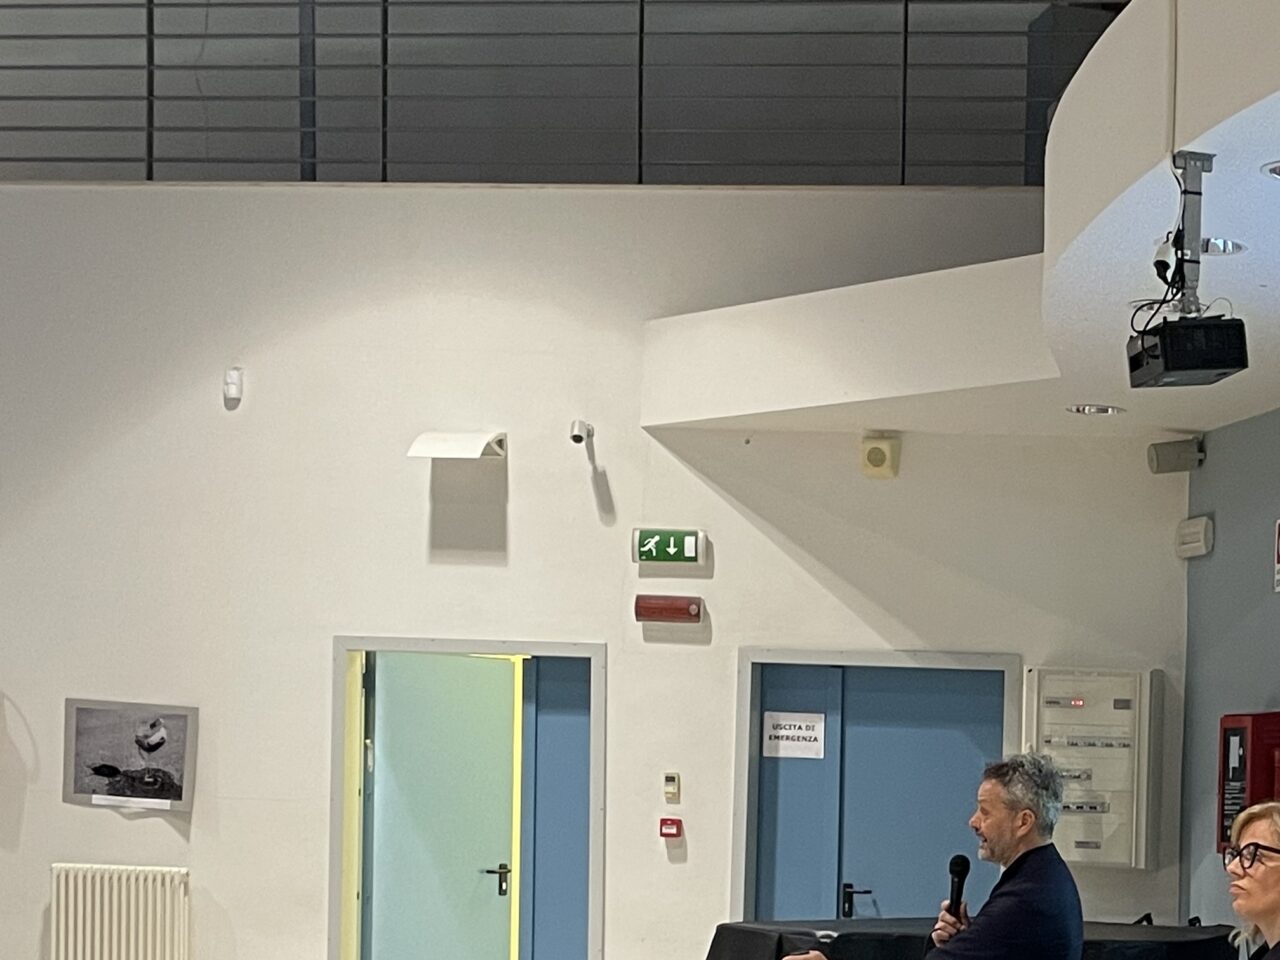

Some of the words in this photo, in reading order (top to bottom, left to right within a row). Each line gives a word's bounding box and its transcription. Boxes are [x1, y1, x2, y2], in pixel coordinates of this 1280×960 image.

[772, 723, 802, 731] USCITA
[805, 724, 816, 732] DI
[769, 734, 819, 743] EMERGENZA
